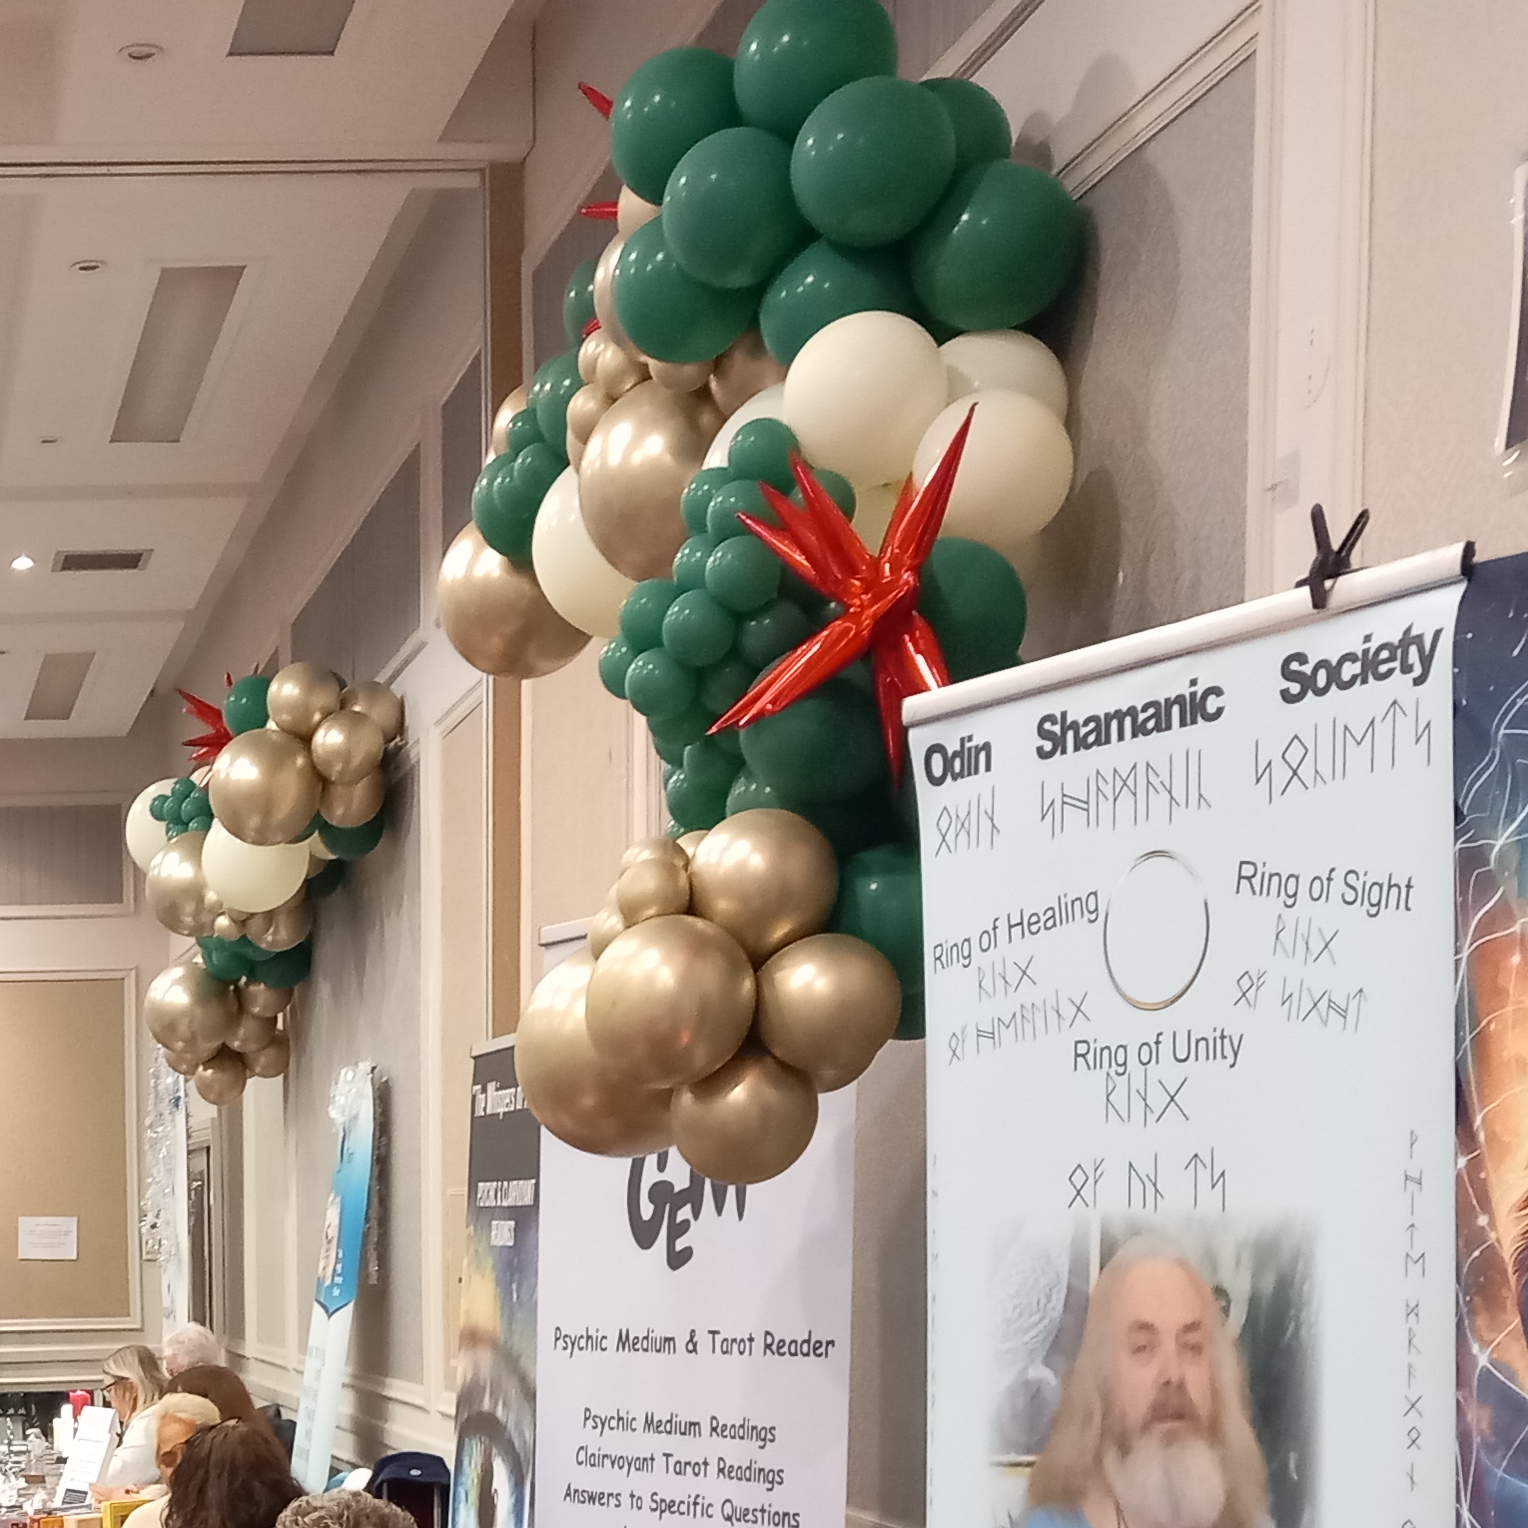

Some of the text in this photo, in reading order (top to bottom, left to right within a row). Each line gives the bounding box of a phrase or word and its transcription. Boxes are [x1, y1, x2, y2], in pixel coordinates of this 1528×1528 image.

[924, 622, 1445, 787] Odin Shamanic Society
[1235, 860, 1414, 918] Ring of Sight
[933, 890, 1099, 975] Ring of Healing
[1074, 1027, 1244, 1077] Ring of Unity
[553, 1326, 835, 1359] Psychic Medium & Tarot Reader
[583, 1407, 776, 1449] Psychic Medium Readings
[576, 1445, 784, 1491] Clairvoyant Tarot Readings
[563, 1482, 800, 1528] Answers to Specific Questions
